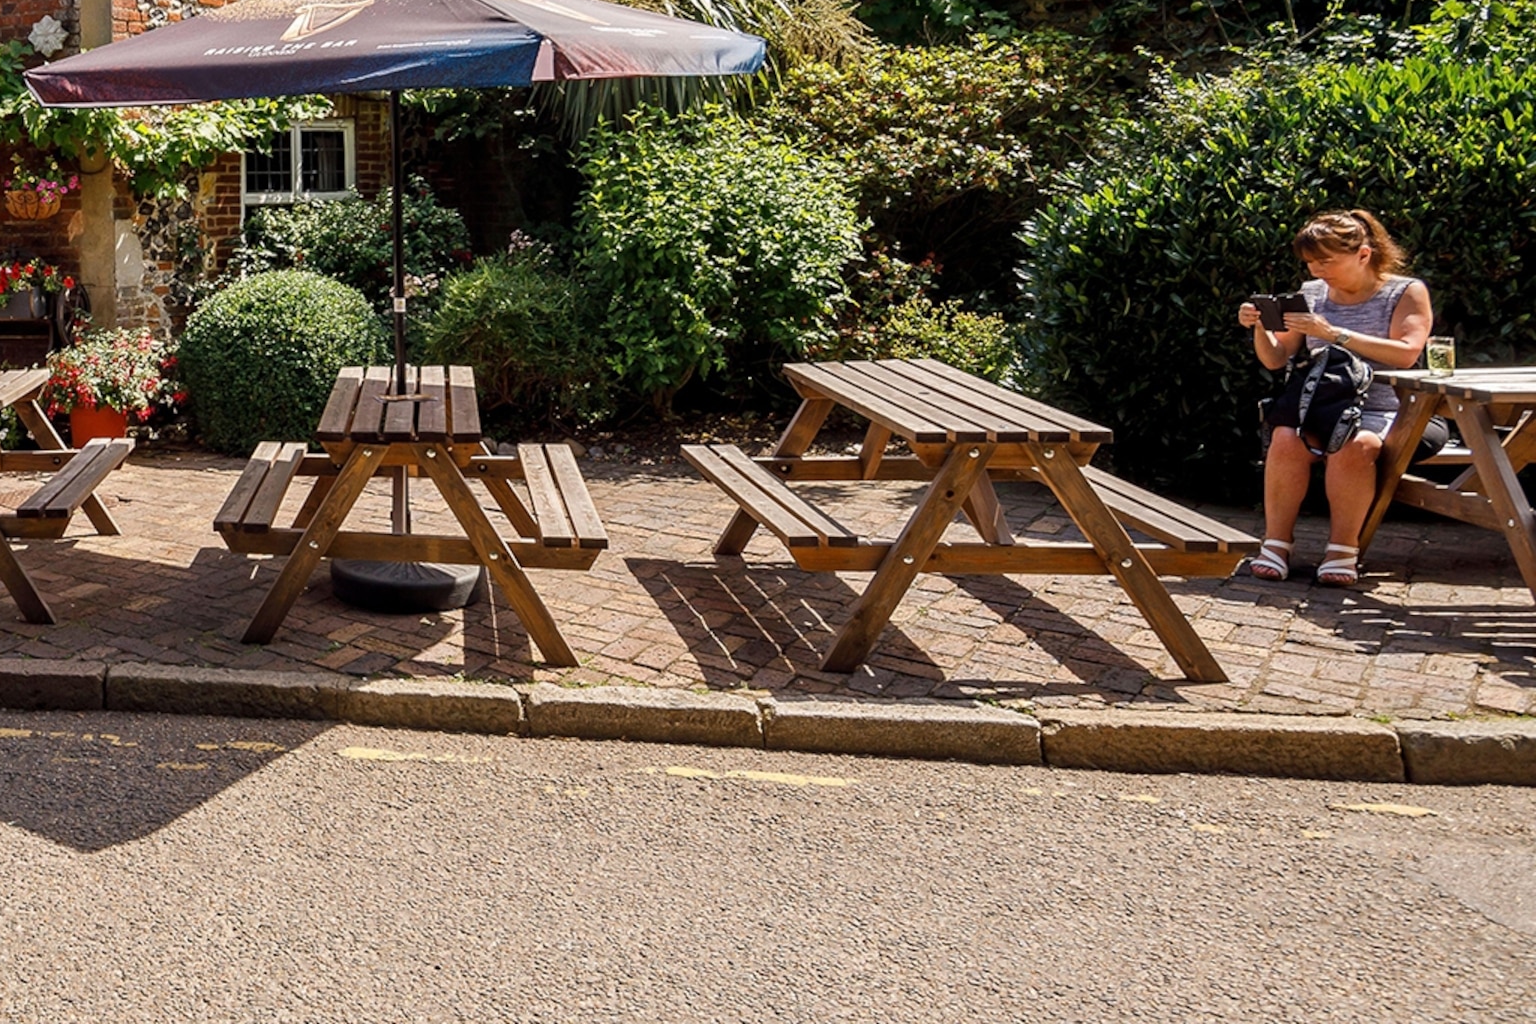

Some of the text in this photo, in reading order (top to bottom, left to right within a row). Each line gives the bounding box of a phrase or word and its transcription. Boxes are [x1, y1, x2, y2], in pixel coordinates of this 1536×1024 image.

[204, 44, 275, 56] RAISING
[281, 42, 316, 51] THE
[320, 39, 358, 49] BAR
